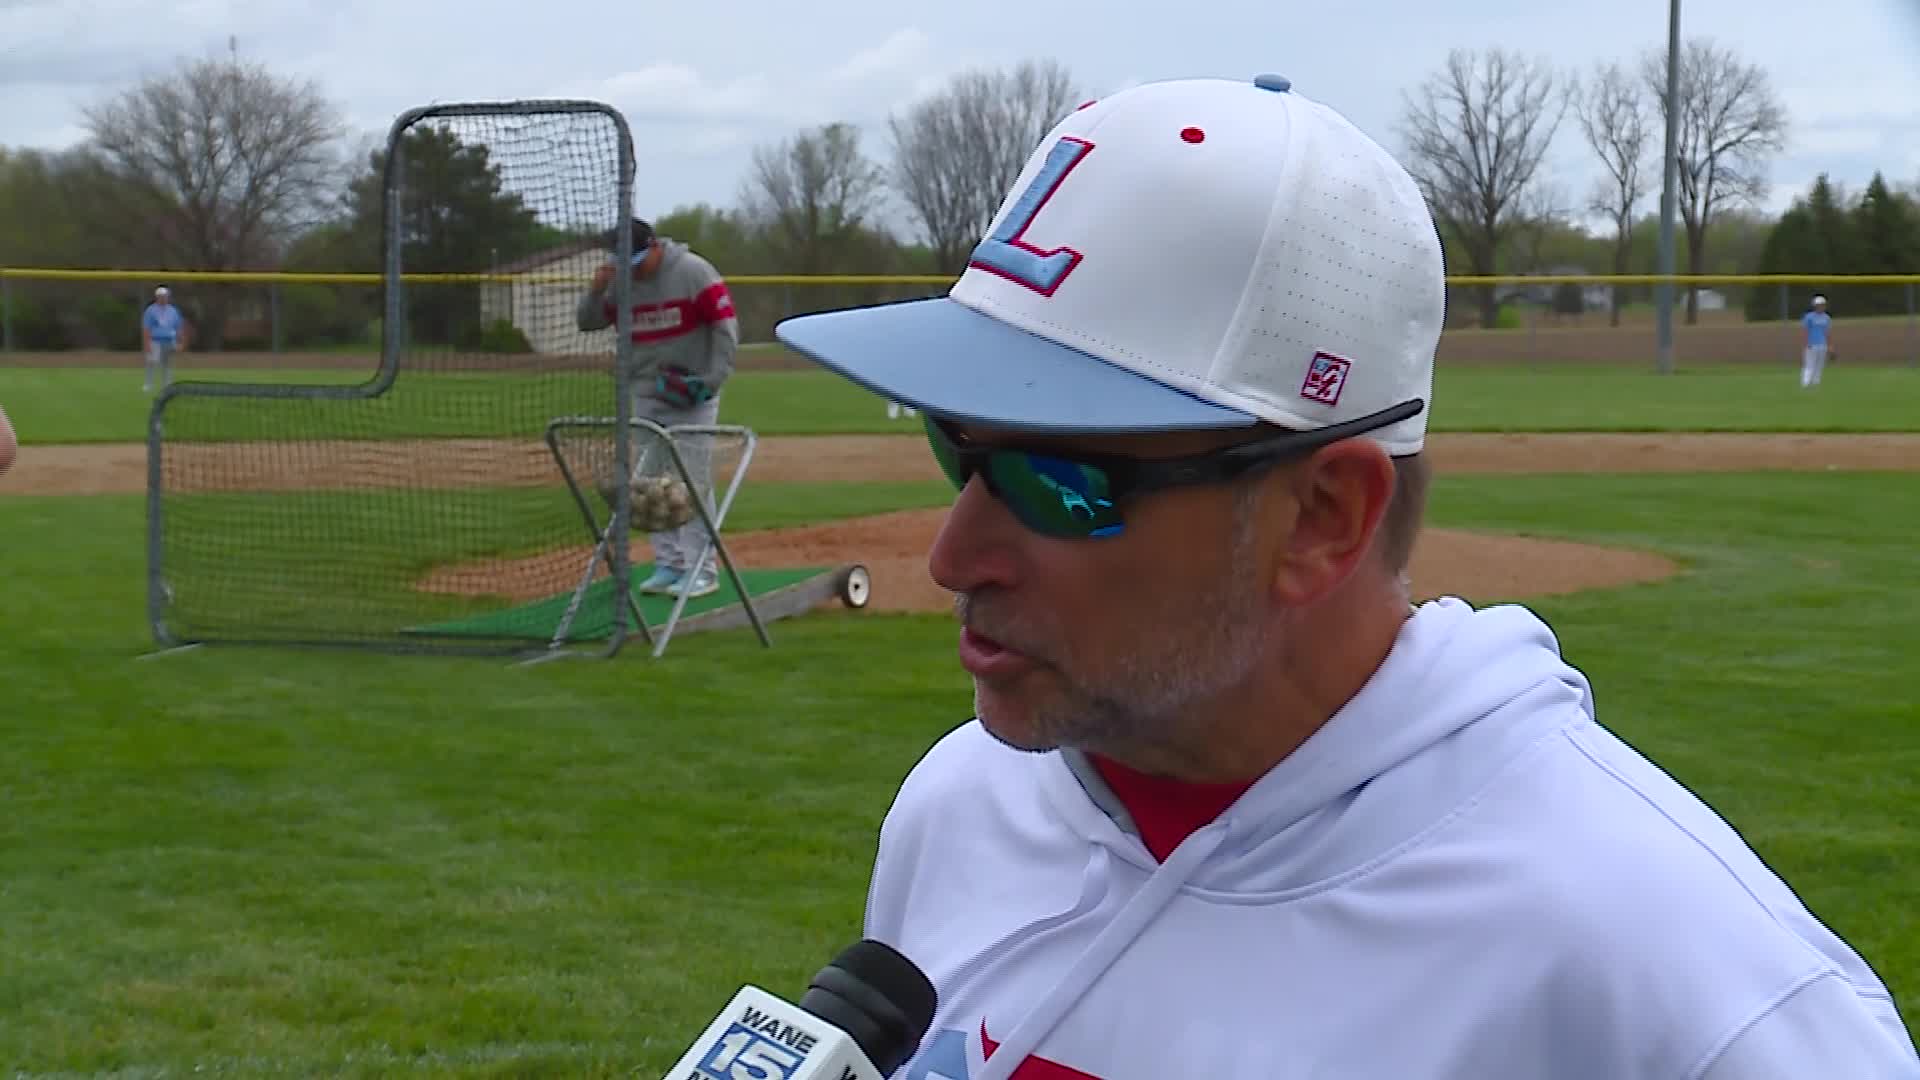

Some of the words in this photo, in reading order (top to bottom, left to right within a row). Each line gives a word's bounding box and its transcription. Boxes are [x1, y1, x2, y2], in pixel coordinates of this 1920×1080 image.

[969, 136, 1096, 297] L
[741, 1006, 819, 1055] WANE
[709, 1031, 800, 1080] 15
